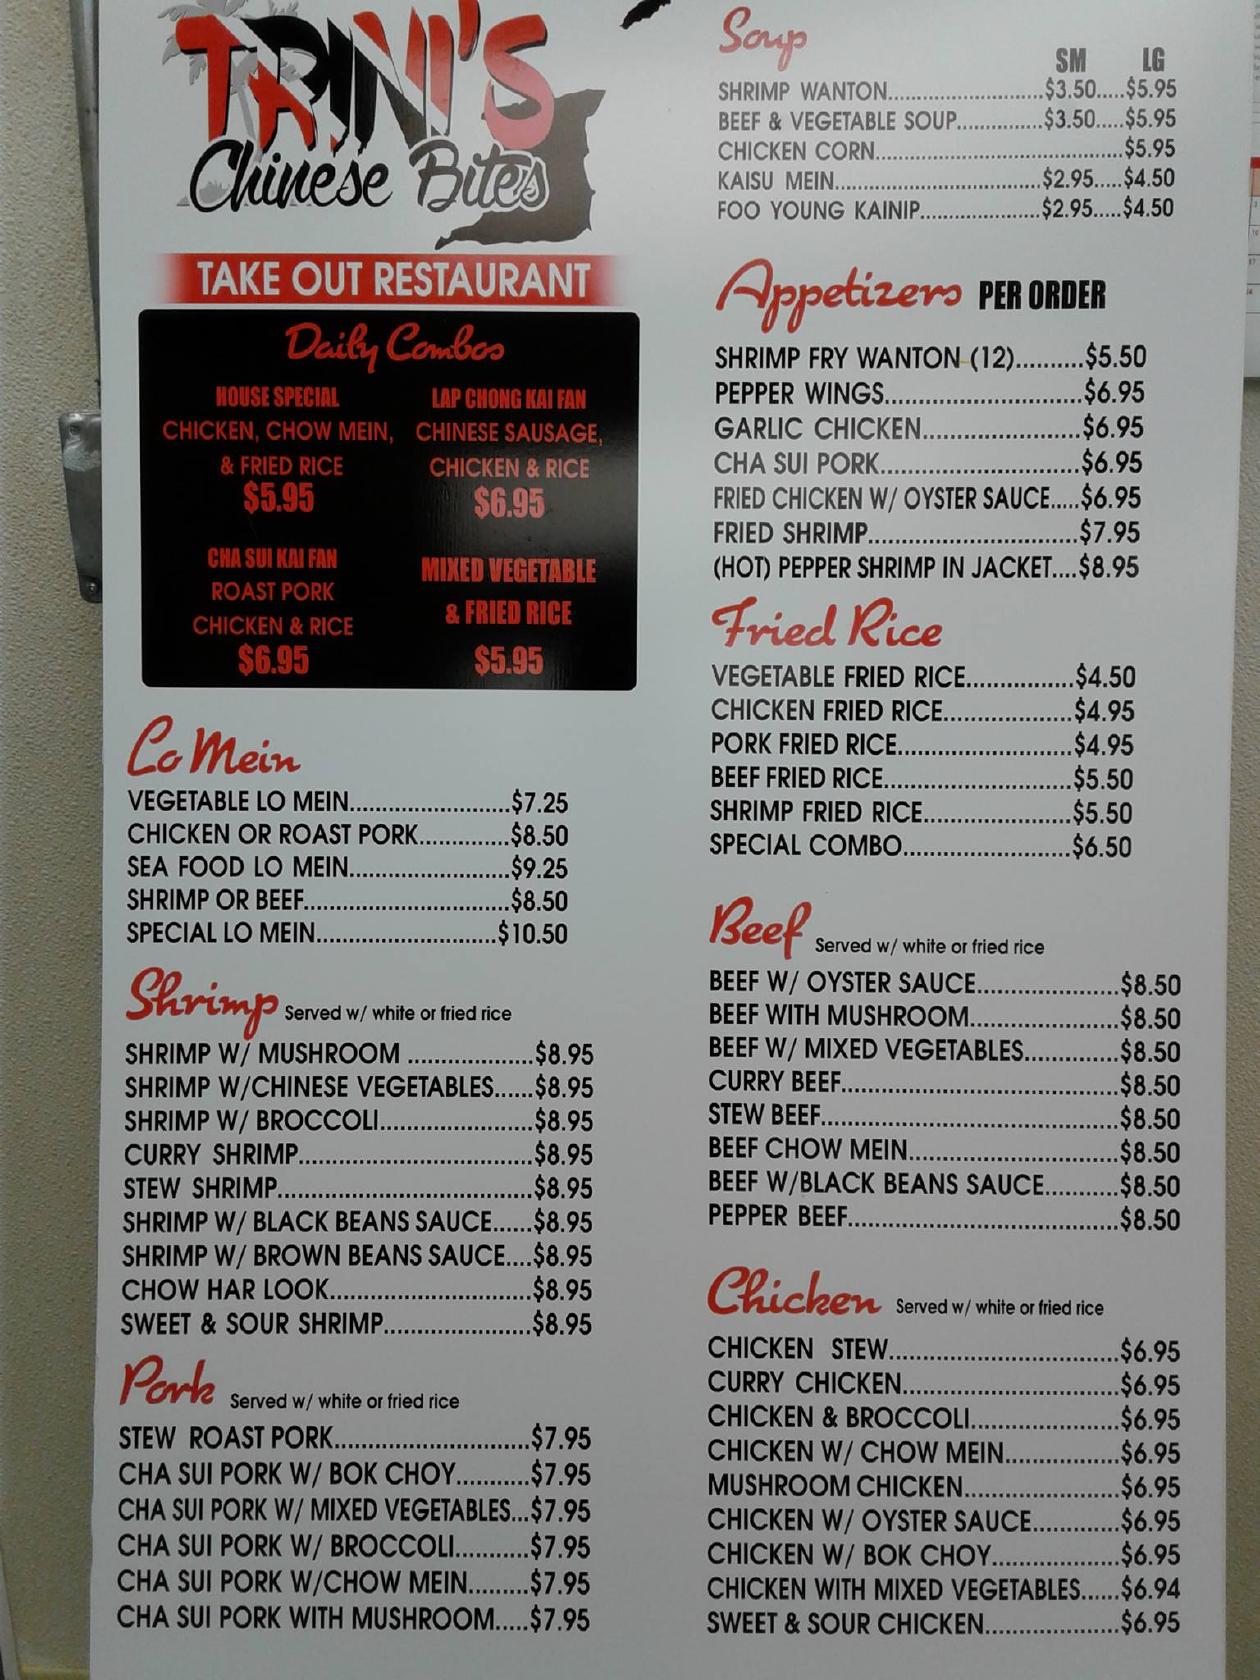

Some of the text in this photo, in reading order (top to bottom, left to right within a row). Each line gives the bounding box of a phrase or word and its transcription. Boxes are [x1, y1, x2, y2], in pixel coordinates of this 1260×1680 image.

[719, 6, 808, 72] Soup
[1055, 46, 1166, 74] SM LG
[718, 75, 1177, 102] SHRIMP WANTON $3.50 $5.95
[190, 137, 548, 213] Chinese Bites
[717, 194, 1175, 221] FOO YOUNG KAINIP $2.95 $4.50
[197, 261, 592, 298] TAKE OUT RESTAURANT
[715, 258, 1107, 334] Appetizers PER ORDER
[285, 321, 506, 374] Daily Combos
[714, 341, 1147, 373] SHRIMP FRY WANTON (12) $5.50
[215, 385, 340, 408] HOUSE SPECIAL
[431, 386, 587, 410] LAP CHONG KAI FAN
[162, 419, 394, 444] CHICKEN, CHOW MEIN,
[415, 421, 603, 446] CHINESE SAUSAGE,
[220, 455, 343, 477] & FRIED RICE
[429, 456, 590, 478] CHICKEN & RICE
[242, 480, 315, 513] $5.95
[474, 487, 546, 519] $6.95
[207, 546, 338, 569] CHA SUI KAI FAN
[421, 556, 596, 584] MIXED VEGETABLE
[713, 552, 1140, 582] (HOT) PEPPER SHRIMP IN JACKET $8.95
[211, 581, 334, 602] ROAST PORK
[192, 615, 354, 637] CHICKEN & RICE
[445, 598, 572, 626] & FRIED RICE
[711, 595, 943, 648] Fried Rice
[238, 643, 310, 676] $6.95
[474, 644, 544, 677] $5.95
[711, 662, 1137, 691] VEGETABLE FRIED RICE $4.50
[127, 714, 301, 776] Lo Mein
[127, 787, 569, 816] VEGETABLE LO MEIN $7.25
[709, 832, 1132, 861] SPECIAL COMBO $6.50
[126, 918, 569, 947] SPECIAL LO MEIN $10.50
[709, 895, 1046, 960] Beef Served w/ white or fried rice
[126, 966, 513, 1040] Shrimp Served w/ white or fried rice
[709, 1002, 1182, 1032] BEEF WITH MUSHROOM $8.50
[124, 1039, 595, 1068] SHRIMP W/ MUSHROOM $8.95
[708, 1202, 1181, 1233] PEPPER BEEF $8.50
[706, 1265, 1105, 1317] Chicken Served w/ white or fried rice
[120, 1309, 593, 1338] SWEET & SOUR SHRIMP $8.95
[707, 1335, 1181, 1365] CHICKEN STEW $6.95
[119, 1354, 461, 1411] Pork Served w/ white or fried rice
[118, 1422, 592, 1452] STEW ROAST PORK $7.95
[706, 1574, 1181, 1602] CHICKEN WITH MIXED VEGETABLES $6.94
[116, 1603, 591, 1634] CHA SUI PORK WITH MUSHROOM $7.95
